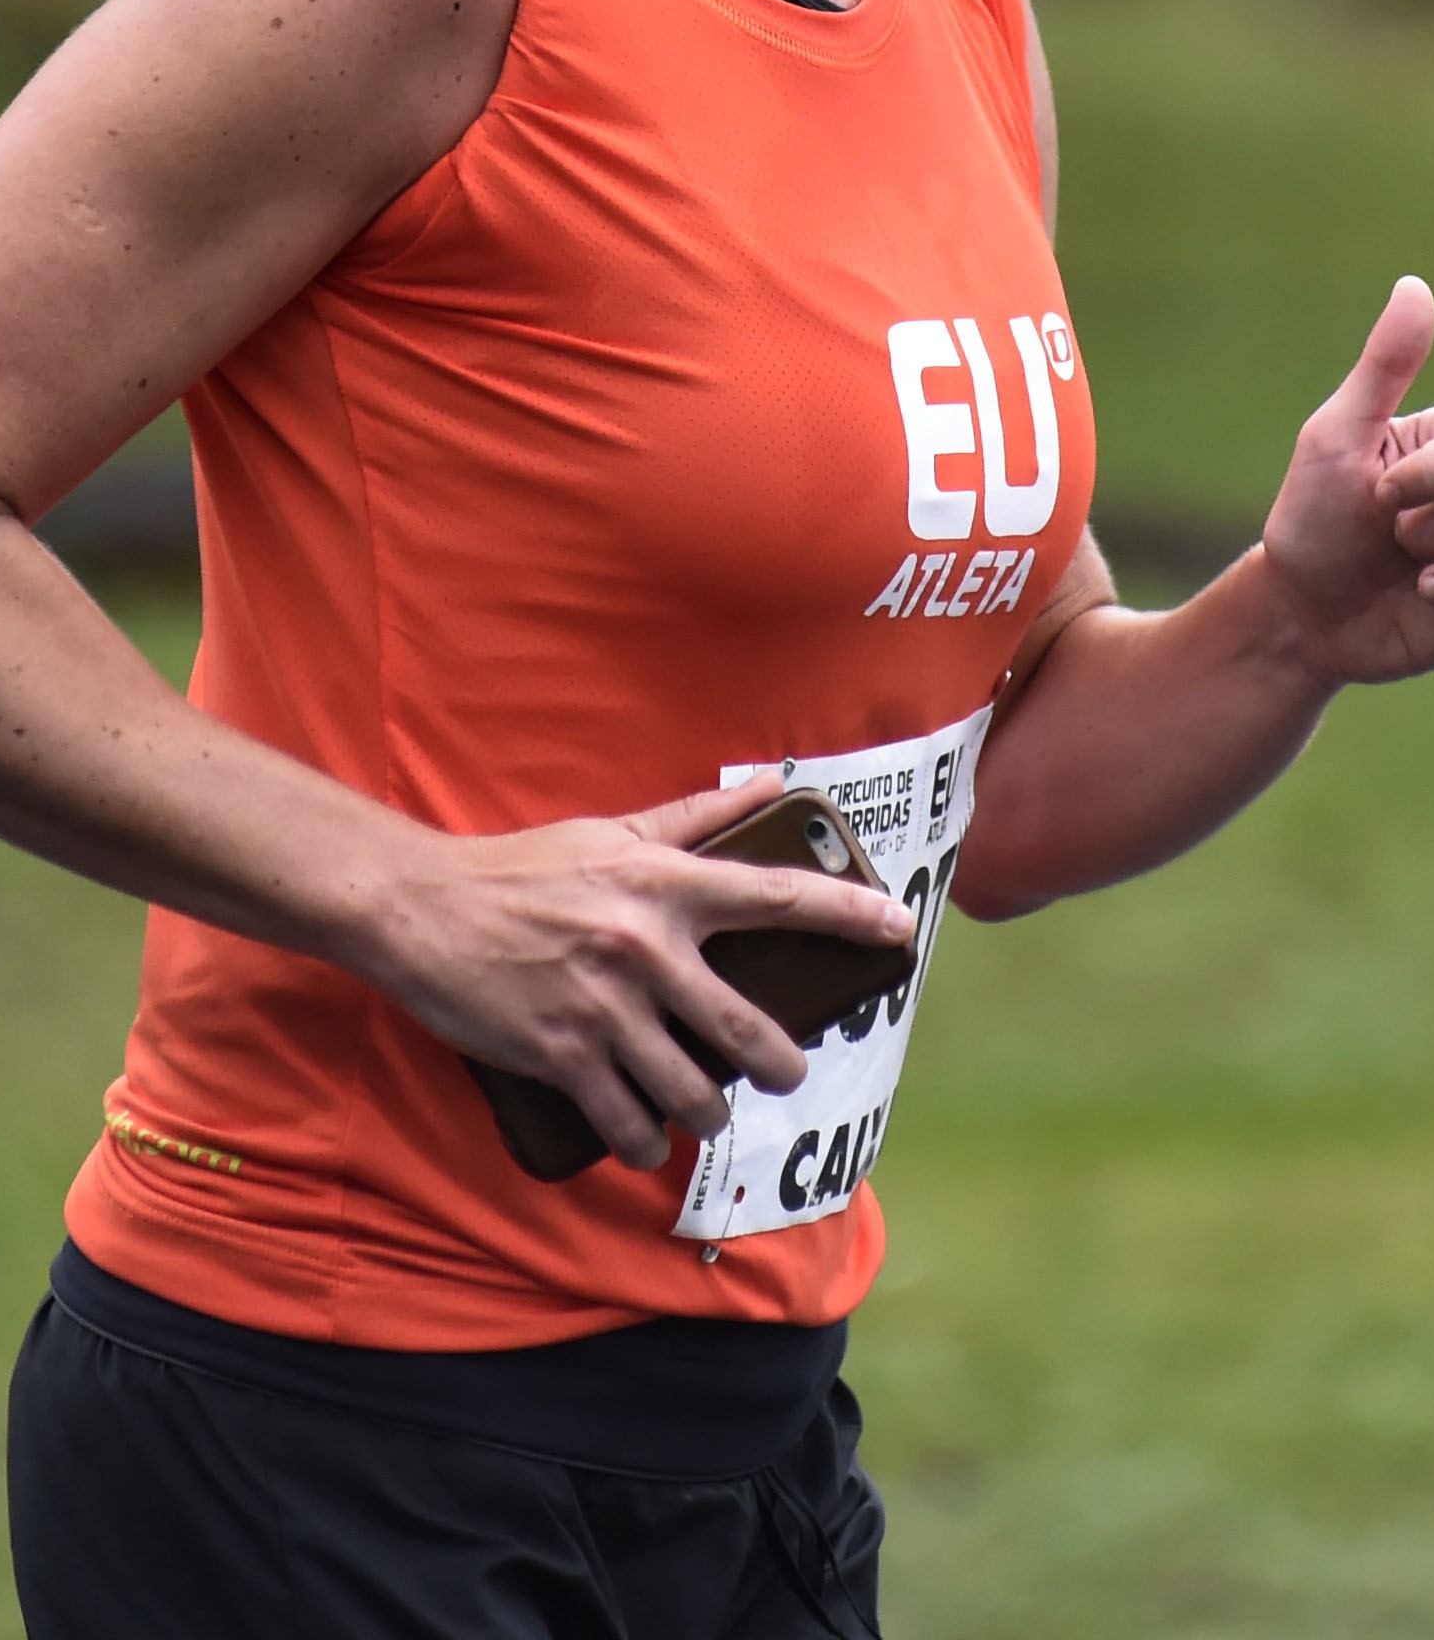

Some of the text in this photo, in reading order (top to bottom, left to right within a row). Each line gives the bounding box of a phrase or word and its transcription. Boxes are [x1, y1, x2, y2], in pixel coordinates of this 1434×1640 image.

[887, 315, 1060, 540] EU
[864, 548, 1035, 618] ATLETA
[828, 769, 914, 807] CIRCUITO DE
[842, 797, 912, 838] RRIDAS
